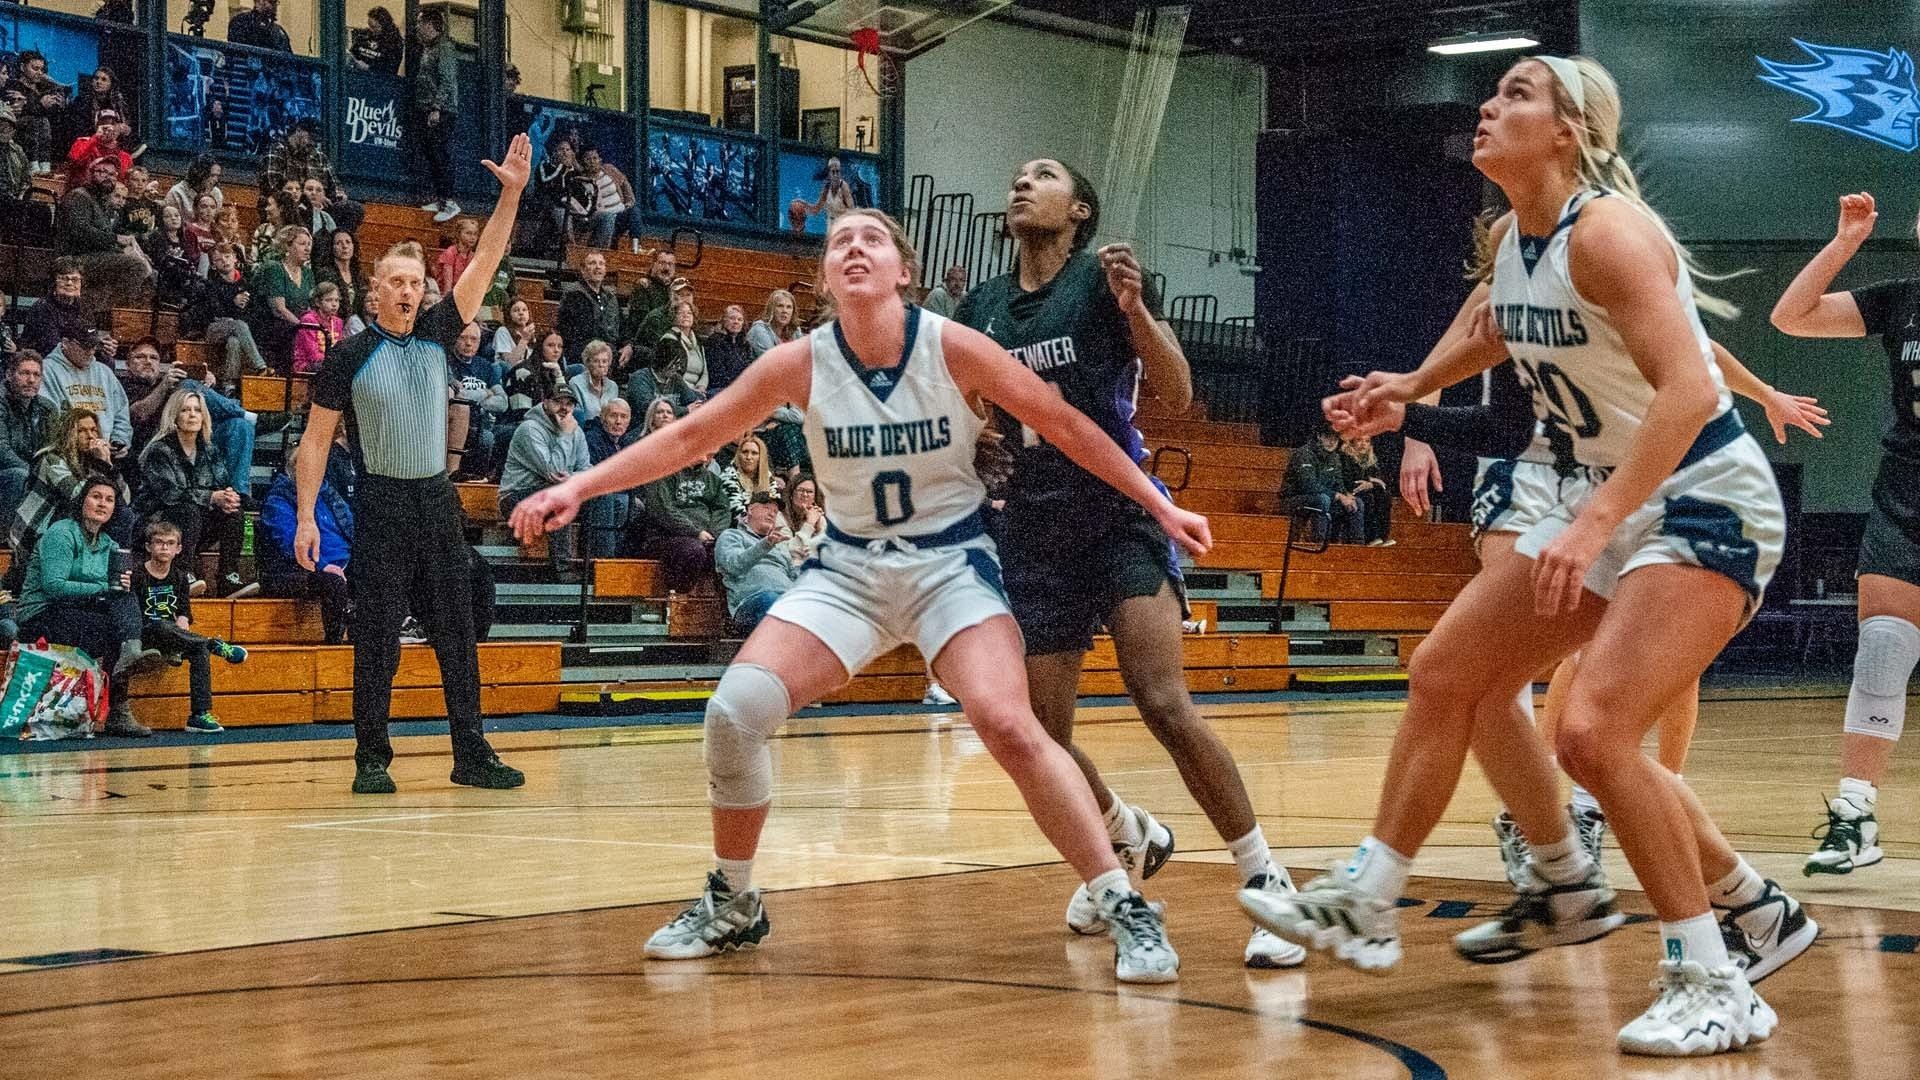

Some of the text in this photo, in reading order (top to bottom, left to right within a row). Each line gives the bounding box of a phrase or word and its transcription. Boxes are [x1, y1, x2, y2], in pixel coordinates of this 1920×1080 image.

[346, 97, 382, 125] Blue
[349, 117, 403, 143] Devils
[1526, 304, 1589, 348] DEVILS
[1901, 340, 1920, 361] WH
[824, 415, 951, 458] BLUE DEVILS
[872, 468, 915, 527] 0
